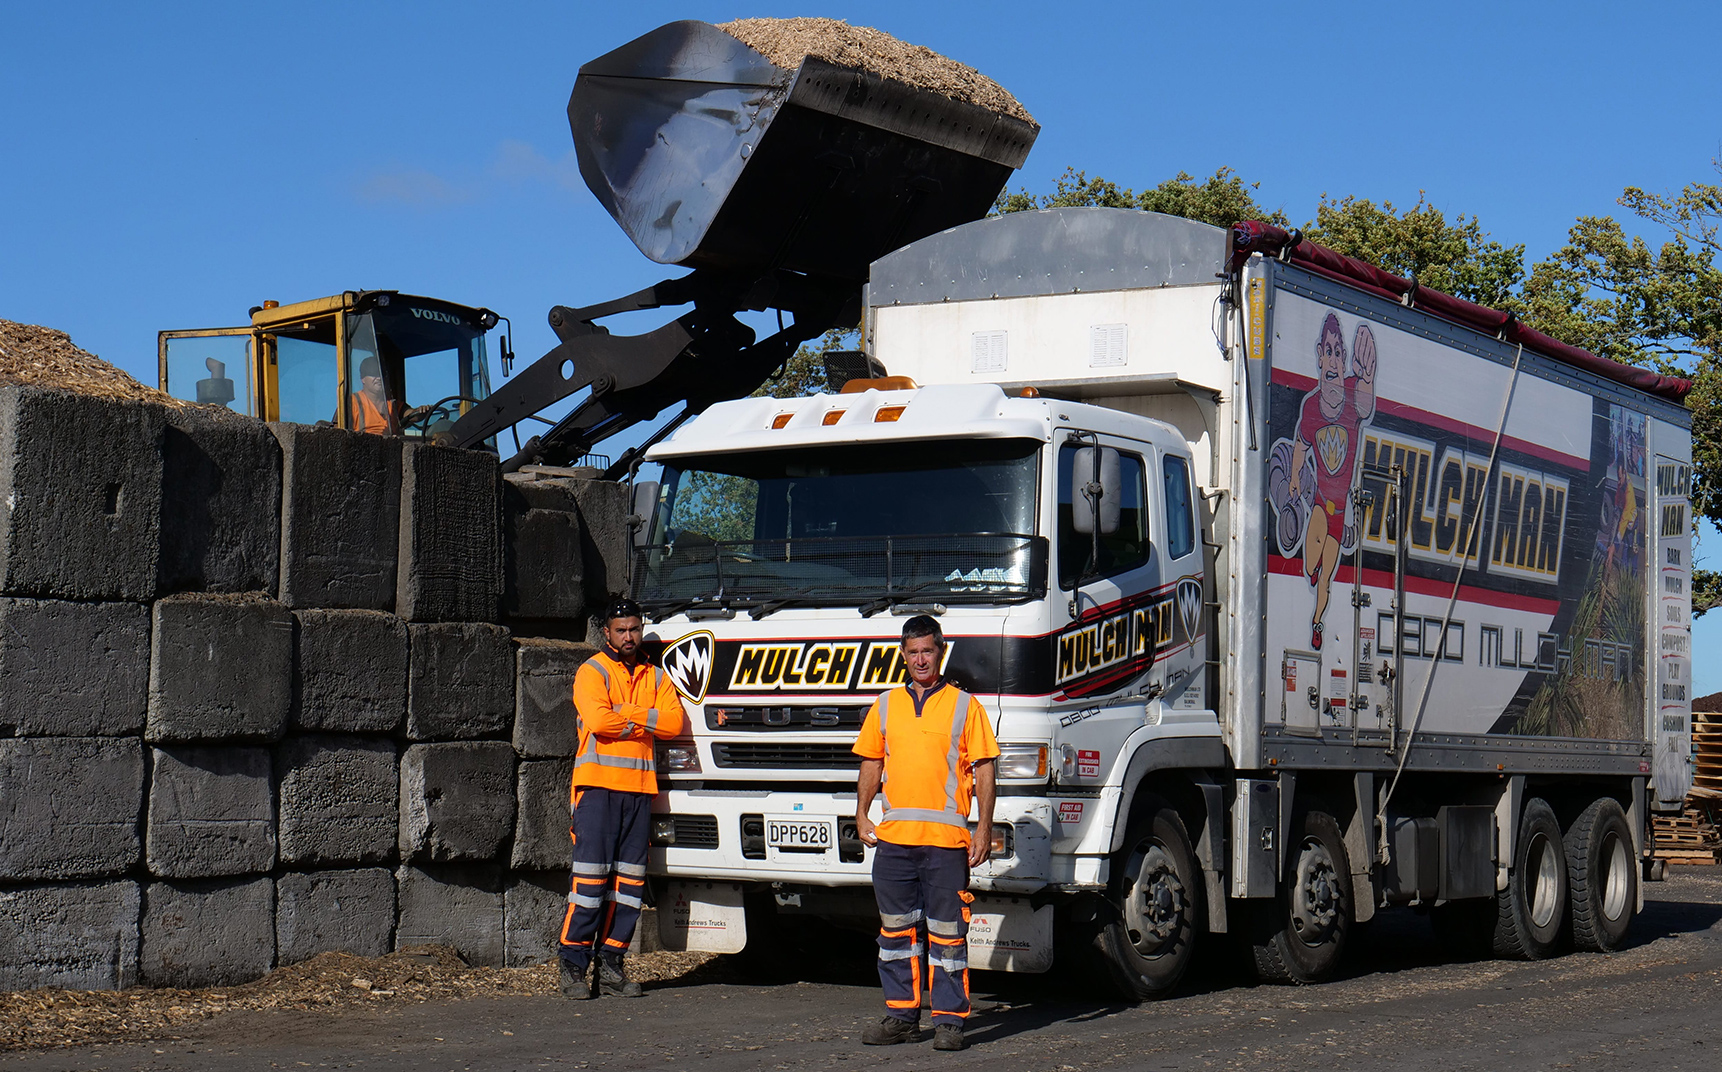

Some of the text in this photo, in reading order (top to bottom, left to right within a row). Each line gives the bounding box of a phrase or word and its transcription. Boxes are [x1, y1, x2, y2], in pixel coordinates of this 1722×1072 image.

[410, 307, 461, 326] VOLVO
[1657, 464, 1692, 496] MULCH
[1361, 432, 1567, 577] MULCH MAN
[1661, 504, 1685, 536] MAN
[1667, 547, 1681, 566] BARK
[1057, 614, 1130, 683] MULCH
[1479, 622, 1574, 676] MULCH
[731, 643, 953, 687] MULCH MA
[1662, 683, 1686, 701] GROUNDS
[1059, 704, 1101, 728] 0800
[1061, 803, 1074, 811] FIRST
[1071, 813, 1079, 821] CAB
[770, 823, 829, 844] DPP628
[709, 919, 727, 927] Trucks
[970, 937, 1030, 948] Keith Andrews Trucks
